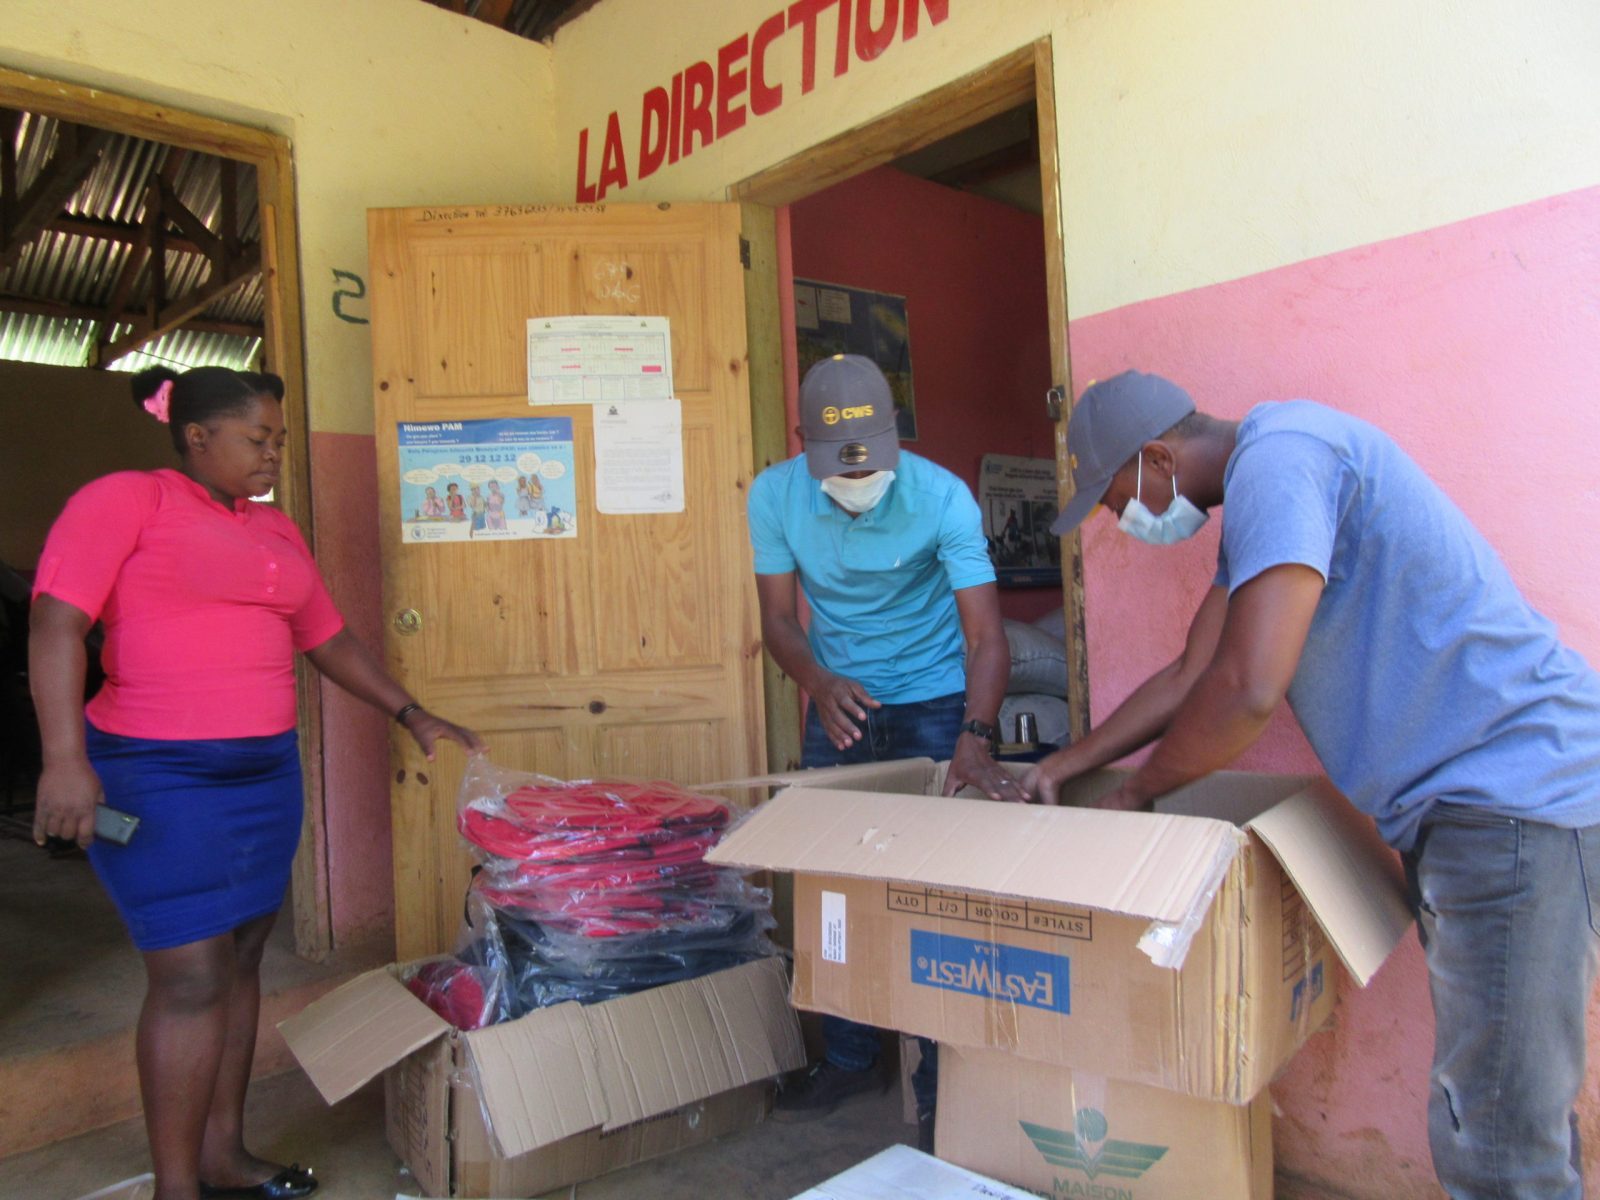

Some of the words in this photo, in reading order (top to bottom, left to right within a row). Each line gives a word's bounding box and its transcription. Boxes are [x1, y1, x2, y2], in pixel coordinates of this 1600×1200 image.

[576, 111, 628, 204] LA
[403, 423, 440, 432] Nimewo
[442, 421, 463, 431] PAM
[895, 894, 918, 907] QTY
[937, 900, 958, 913] C/T
[975, 905, 1019, 922] COLOR
[1033, 915, 1084, 932] STYLE#
[1052, 1176, 1133, 1200] MAISON
